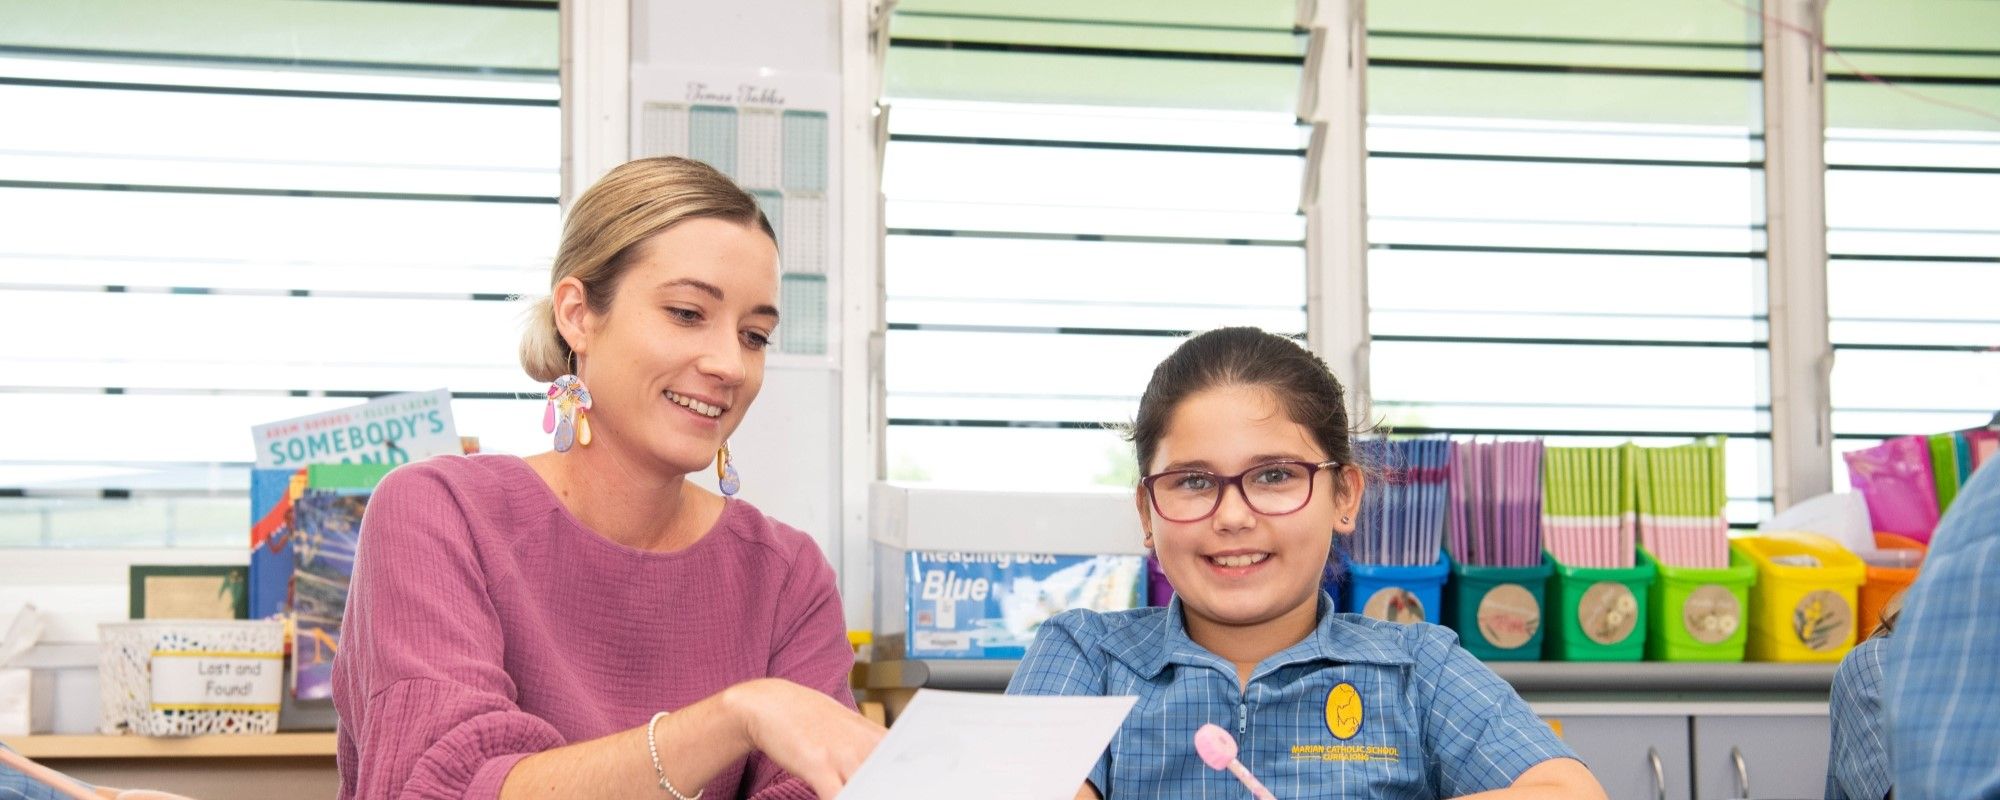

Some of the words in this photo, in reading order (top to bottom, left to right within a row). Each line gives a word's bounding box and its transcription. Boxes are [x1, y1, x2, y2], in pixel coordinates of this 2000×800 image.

[738, 84, 785, 104] Tables
[270, 411, 444, 465] SOMEBODY'S
[922, 570, 988, 601] Blue
[236, 662, 261, 675] and
[205, 680, 253, 696] Found!
[1291, 745, 1325, 753] MARIAN
[1326, 745, 1366, 754] CATHOLIC
[1367, 746, 1398, 755] SCHOOL
